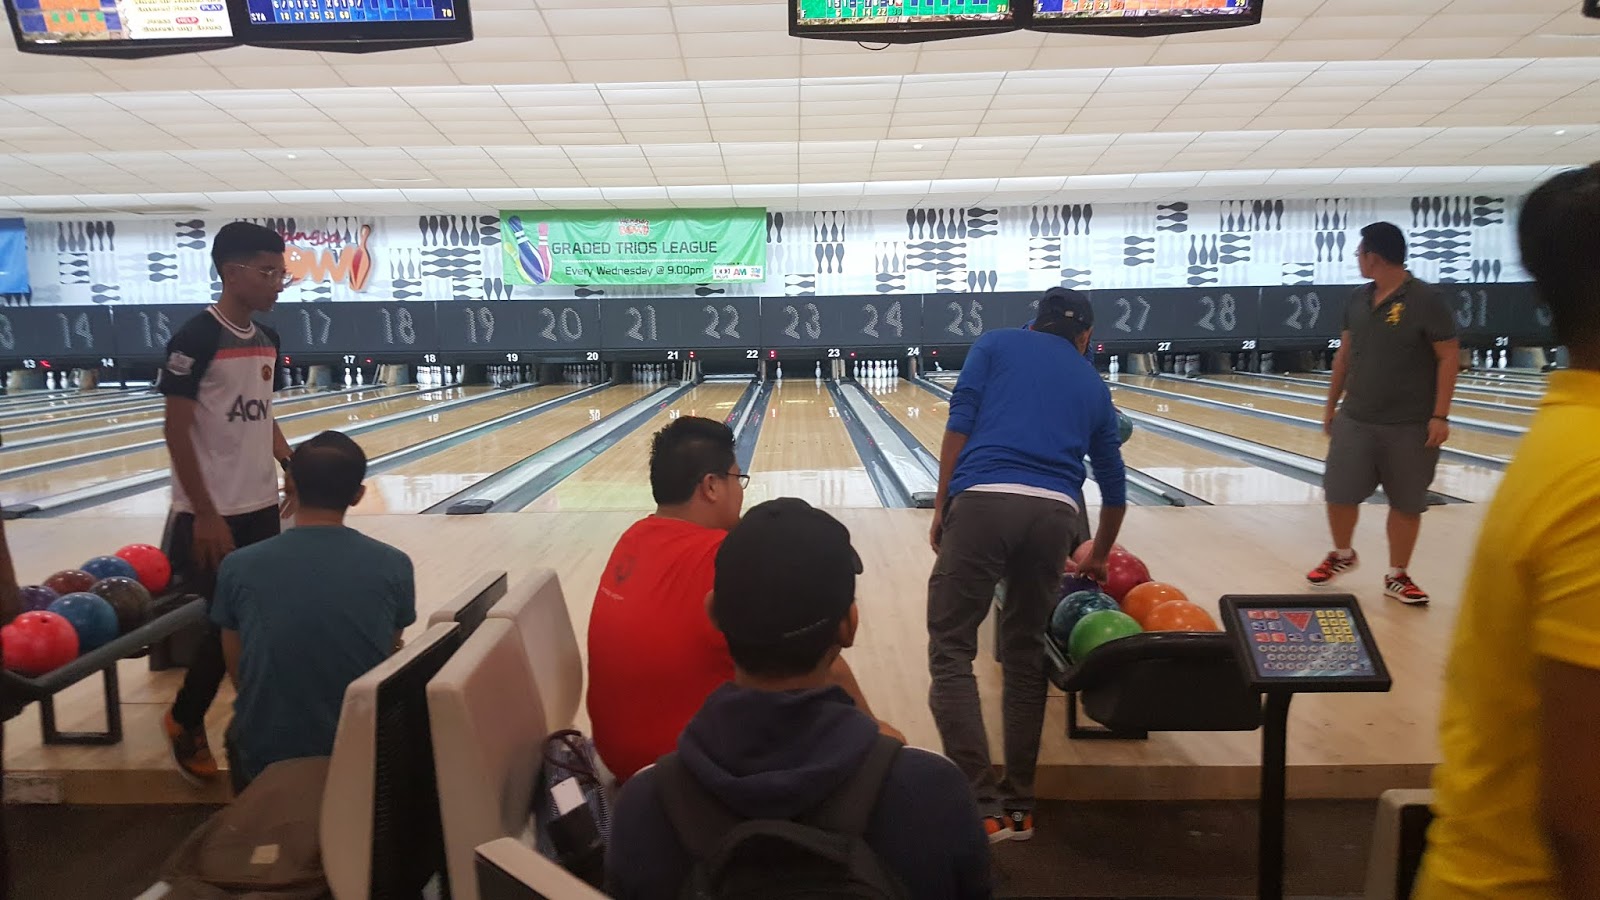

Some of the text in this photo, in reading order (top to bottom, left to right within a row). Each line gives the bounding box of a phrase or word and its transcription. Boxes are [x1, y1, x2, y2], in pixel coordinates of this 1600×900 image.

[294, 12, 305, 21] 27
[324, 11, 335, 20] 53
[862, 8, 872, 17] 14
[876, 8, 887, 16] 22
[279, 228, 343, 247] angsa
[551, 241, 718, 255] GRADED TRIOS LEAGUE
[565, 265, 705, 277] Every Wednesday @ 9.00pm
[1115, 295, 1150, 332] 27
[1198, 293, 1236, 331] 28
[1285, 291, 1321, 330] 29
[1457, 289, 1488, 328] 31
[465, 306, 495, 343] 19
[540, 307, 583, 342] 20
[626, 305, 658, 341] 21
[702, 305, 740, 339] 22
[784, 303, 822, 339] 23
[862, 301, 903, 338] 24
[948, 299, 984, 336] 25
[0, 313, 15, 350] 3
[57, 312, 94, 348] 14
[139, 310, 172, 348] 15
[301, 308, 332, 345] 17
[379, 307, 416, 344] 18
[1158, 342, 1171, 351] 27
[1242, 340, 1256, 350] 28
[1327, 339, 1342, 349] 29
[1495, 336, 1509, 346] 31
[424, 354, 436, 363] 18
[506, 353, 518, 362] 19
[586, 352, 599, 361] 20
[667, 351, 679, 360] 21
[746, 350, 759, 359] 22
[828, 348, 840, 357] 23
[907, 347, 920, 356] 24
[22, 359, 36, 369] 13
[101, 358, 114, 368] 14
[343, 355, 356, 364] 17
